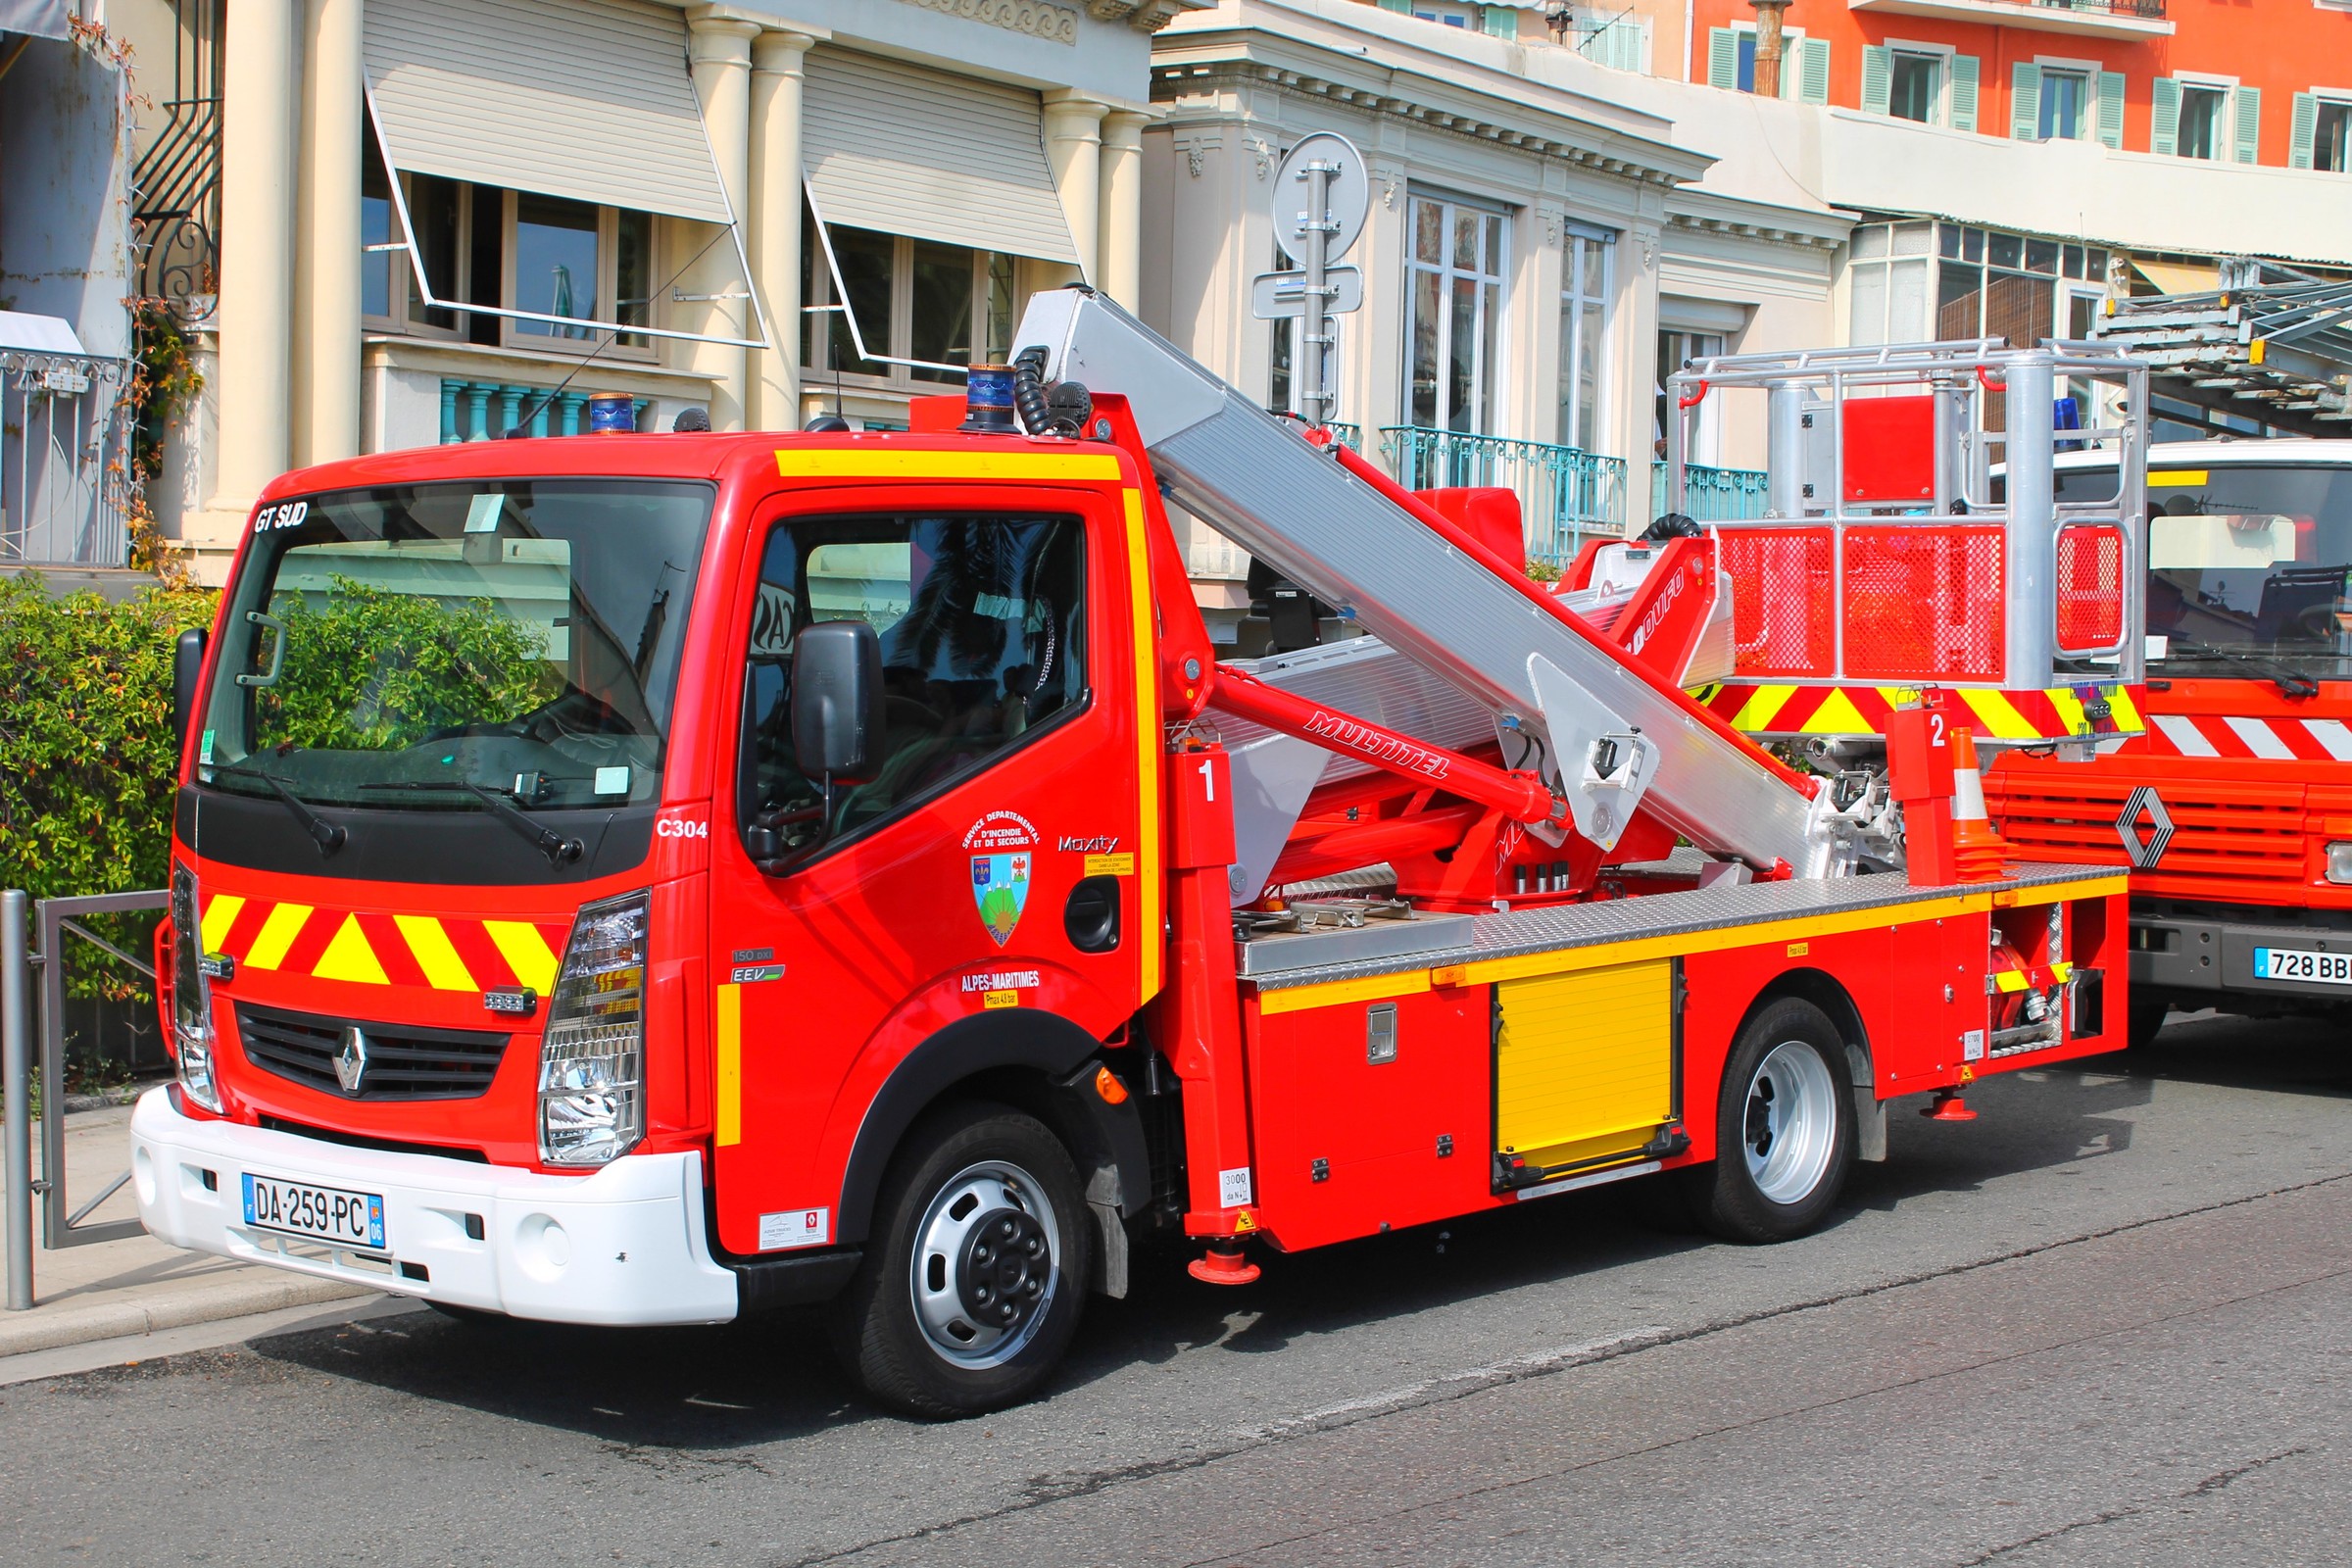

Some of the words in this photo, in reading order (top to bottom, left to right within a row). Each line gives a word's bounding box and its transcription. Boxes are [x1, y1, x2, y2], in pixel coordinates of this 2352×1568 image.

[255, 507, 277, 533] GT
[274, 502, 308, 529] SUD
[1931, 713, 1945, 747] 2
[1303, 710, 1450, 780] MULTITEL
[1198, 759, 1214, 802] 1
[657, 818, 709, 839] C304
[961, 817, 985, 850] SERVICE
[986, 810, 1041, 845] DEPARTEMENTAL
[981, 828, 1022, 838] D'INCENDIE
[973, 840, 982, 849] ET
[997, 836, 1030, 847] SECOURS
[1058, 834, 1119, 855] Maxity
[733, 968, 765, 982] EEV
[2272, 953, 2314, 977] 728
[2320, 956, 2352, 980] BB
[961, 970, 1039, 992] ALPES-MARITIMES
[1225, 1172, 1247, 1186] 3000
[247, 1203, 253, 1215] F
[370, 1222, 382, 1242] 06
